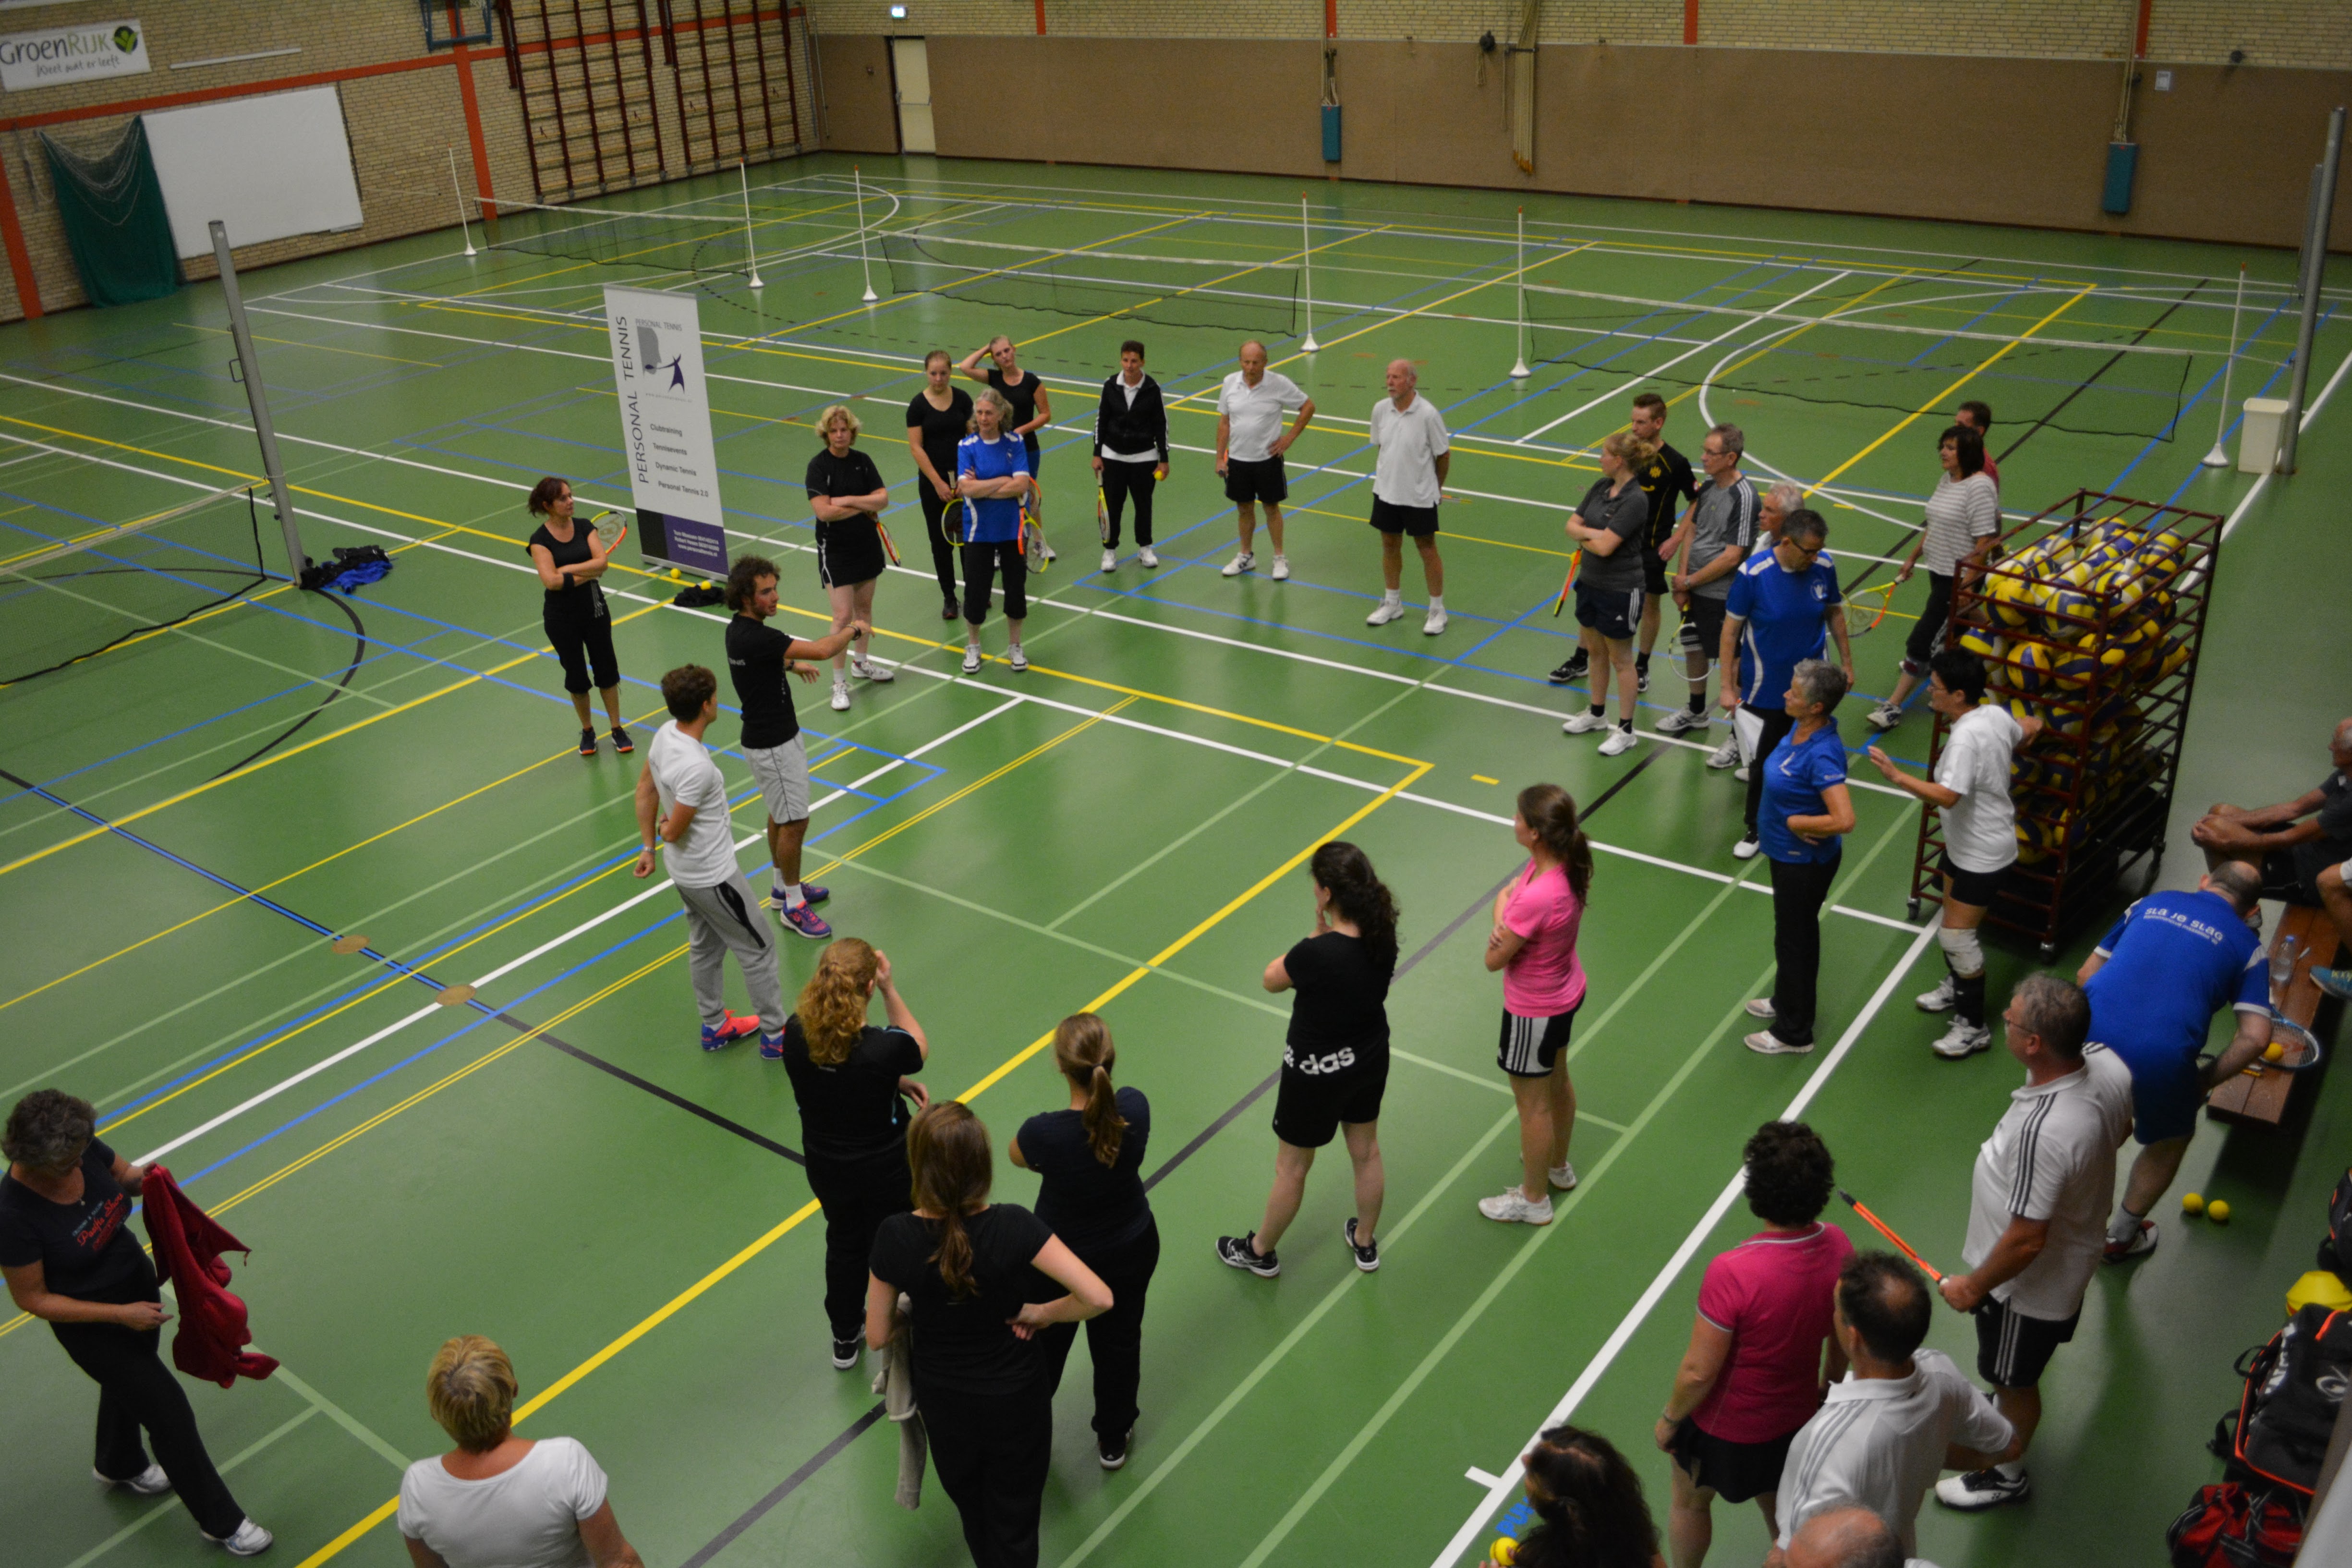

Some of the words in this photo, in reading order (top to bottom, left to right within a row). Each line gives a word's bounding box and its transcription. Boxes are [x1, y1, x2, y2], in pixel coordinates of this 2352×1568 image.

[635, 318, 662, 329] PERSONAL
[663, 321, 682, 331] TENNIS
[616, 316, 634, 381] TENNIS
[627, 391, 649, 484] PERSONAL
[650, 424, 683, 437] Clubtraining
[653, 442, 688, 455] Tennisevents
[655, 462, 678, 473] Dynamic
[679, 466, 696, 476] Tennis
[658, 481, 681, 491] Personal
[682, 486, 699, 496] Tennis
[700, 489, 709, 498] 2.0
